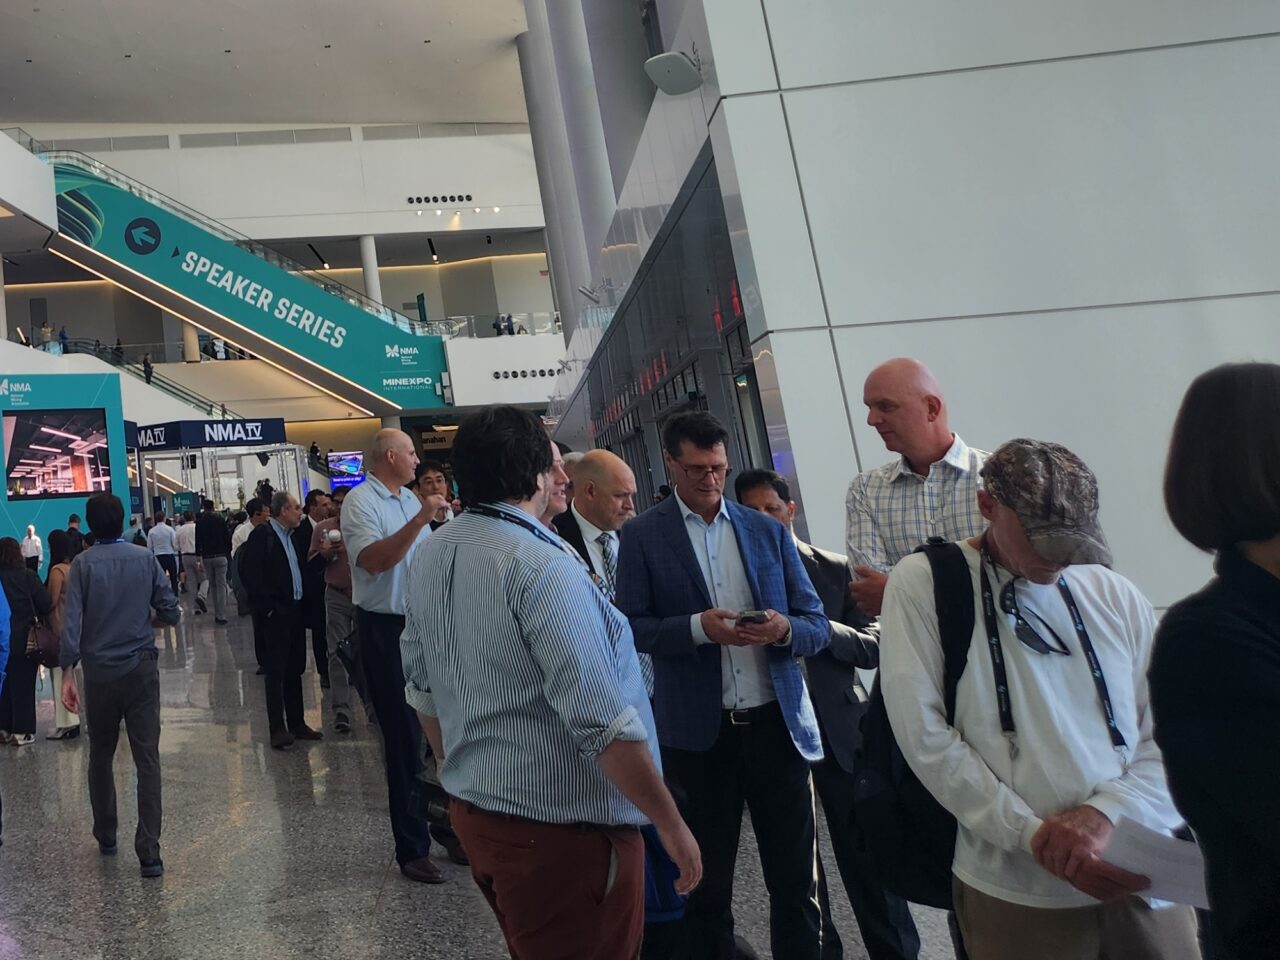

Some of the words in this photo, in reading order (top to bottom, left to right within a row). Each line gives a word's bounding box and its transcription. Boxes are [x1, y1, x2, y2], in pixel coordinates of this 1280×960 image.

[181, 251, 274, 312] SPEAKER
[274, 297, 347, 348] SERIES
[400, 347, 419, 355] NMA
[382, 377, 432, 386] MINEXPO
[10, 382, 32, 392] NMA
